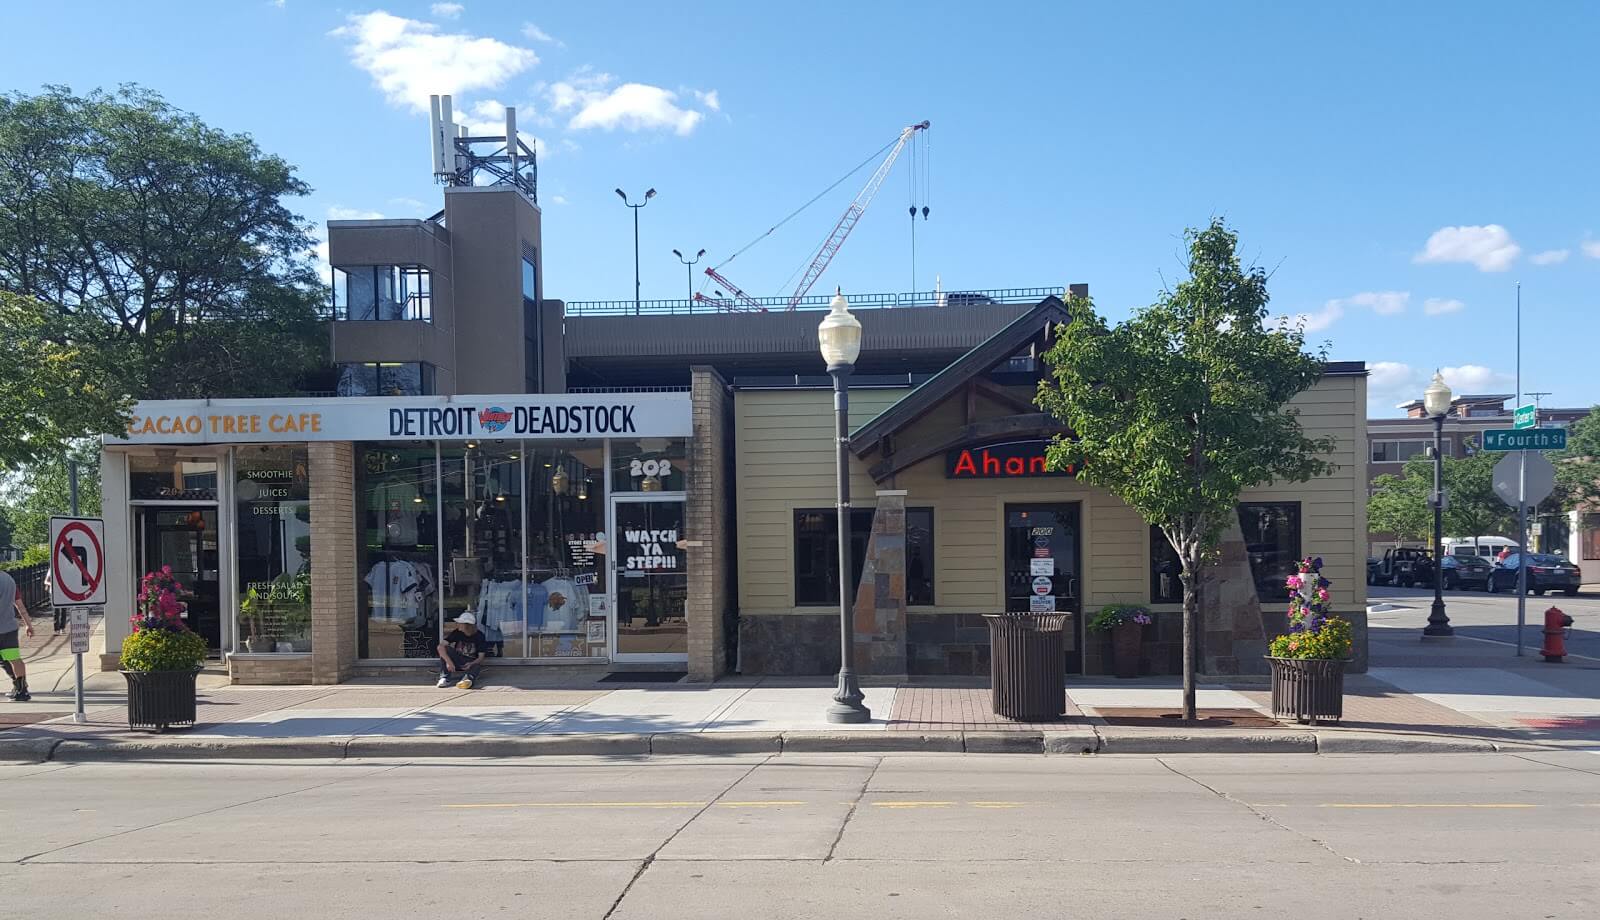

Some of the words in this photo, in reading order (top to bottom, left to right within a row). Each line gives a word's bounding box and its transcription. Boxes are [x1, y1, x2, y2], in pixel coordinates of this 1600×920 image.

[128, 415, 203, 434] CACAO
[208, 414, 262, 433] TREE
[268, 413, 322, 433] CAFE
[389, 407, 476, 436] DETROIT
[514, 404, 636, 434] DEADSTOCK
[1486, 435, 1494, 444] W
[1498, 433, 1548, 446] Fourth
[1552, 434, 1563, 444] St
[247, 470, 293, 479] SMOOTHIE
[630, 459, 671, 477] 202
[258, 488, 288, 499] JUICES
[253, 506, 293, 515] DESSERTS
[625, 530, 677, 543] WATCH
[1031, 527, 1053, 536] 200
[641, 543, 663, 556] YA
[247, 582, 273, 590] FRESH
[276, 582, 303, 590] SALAD
[576, 575, 594, 584] OPEN
